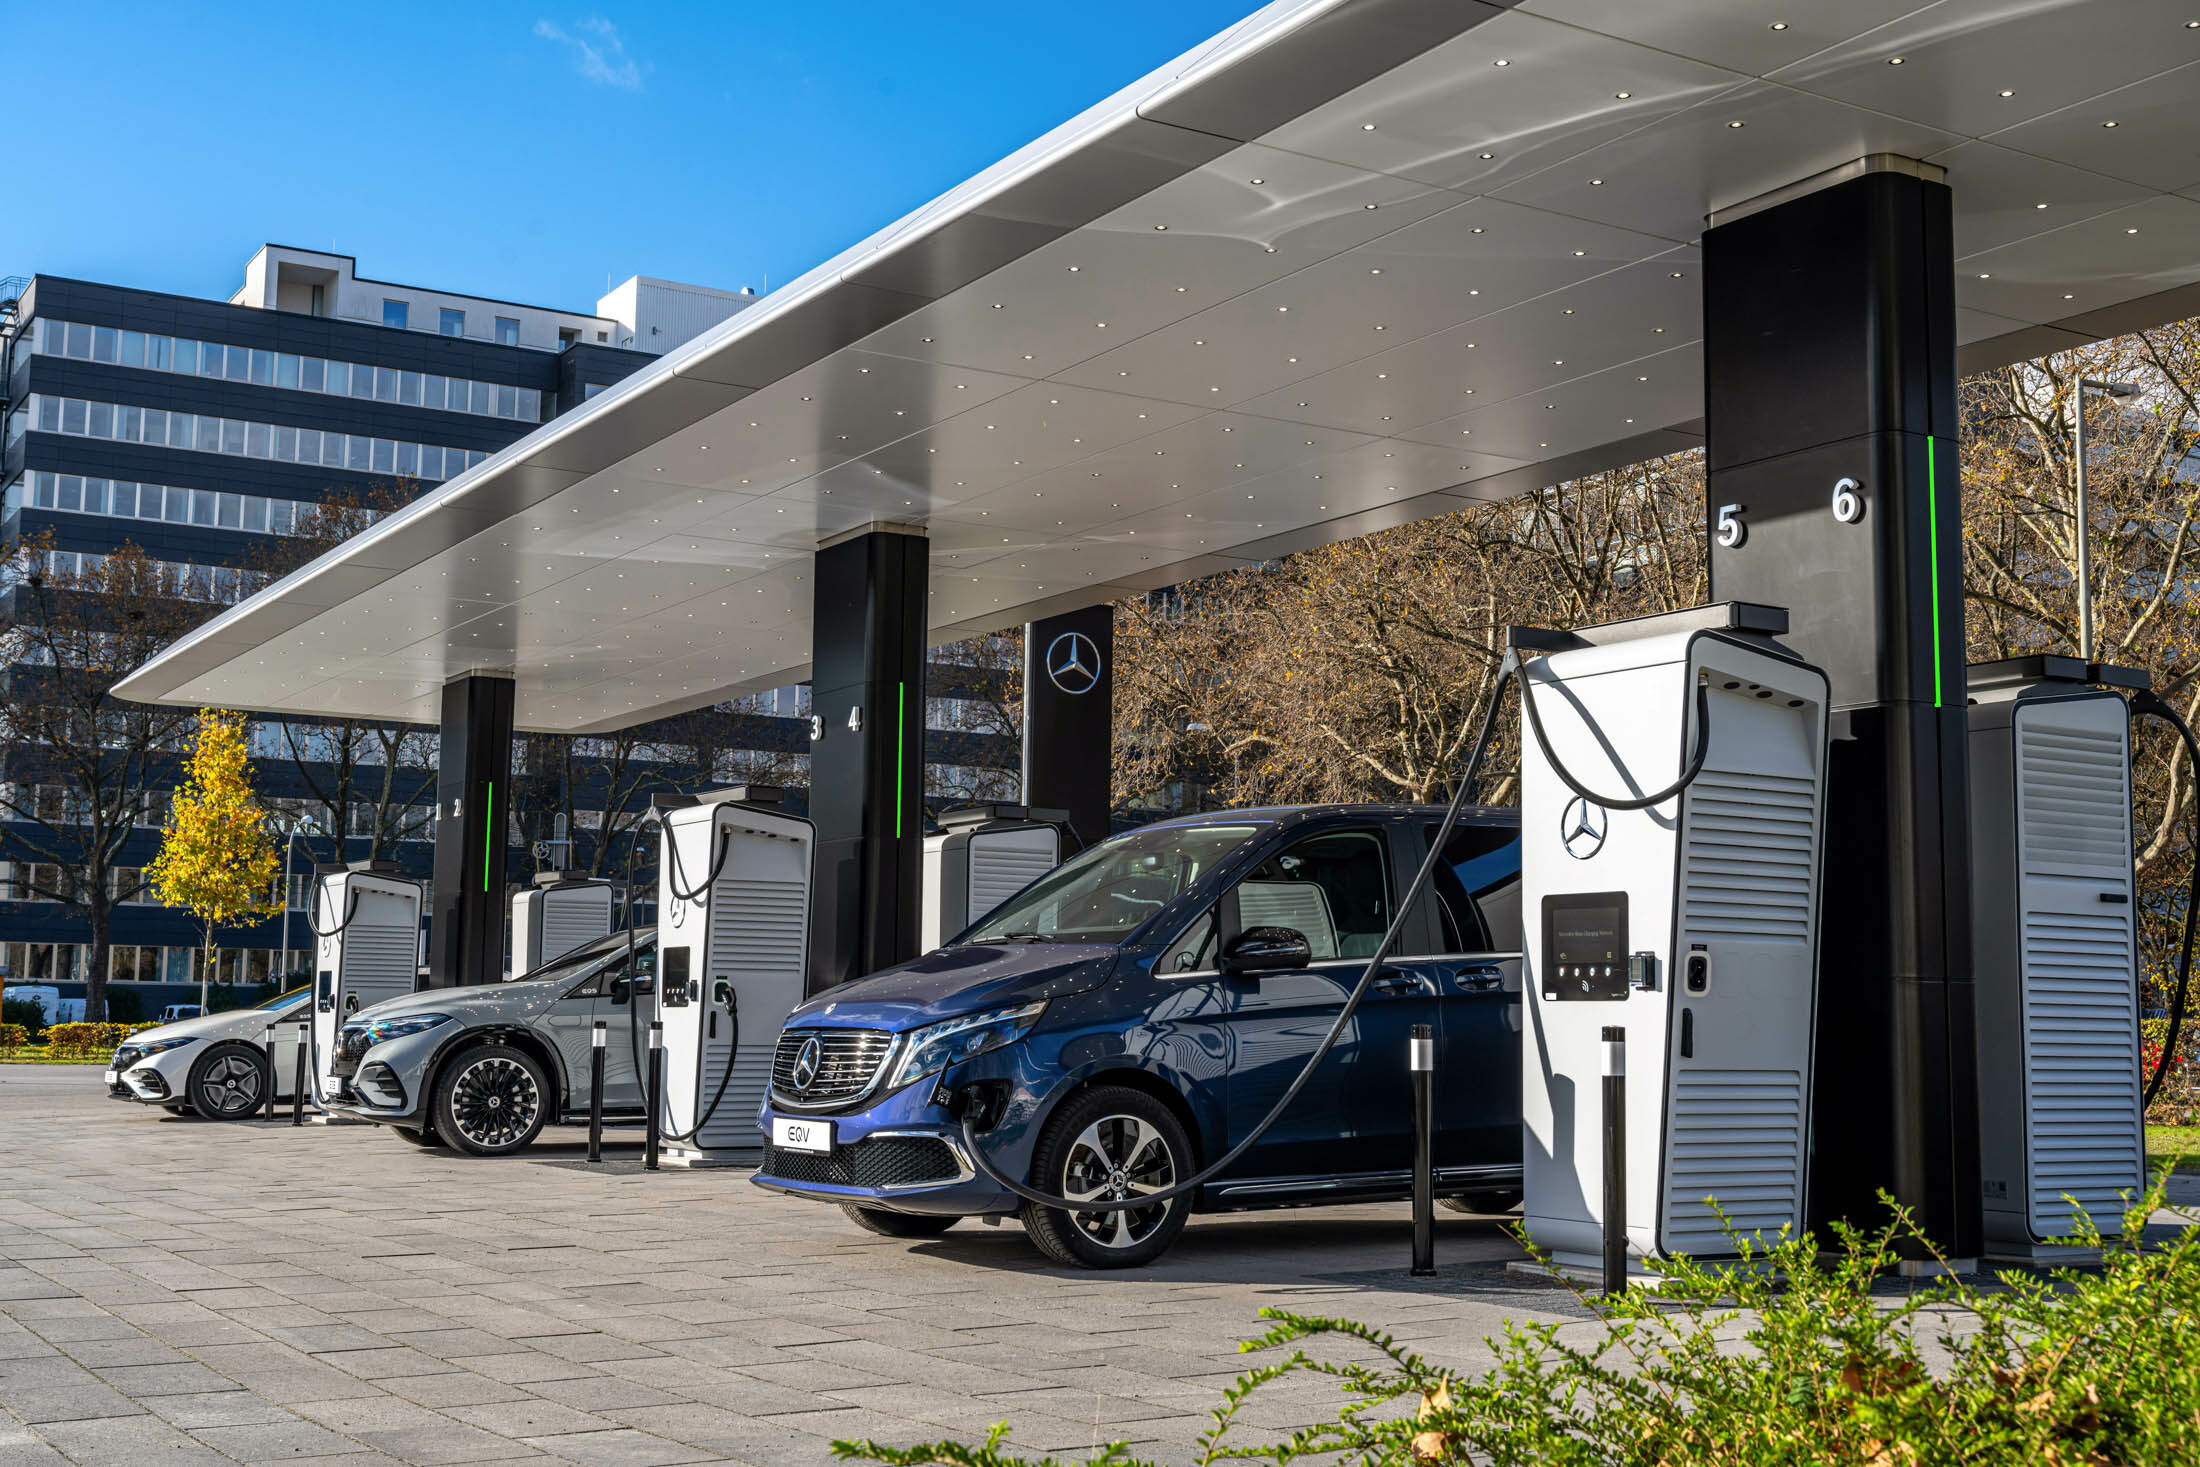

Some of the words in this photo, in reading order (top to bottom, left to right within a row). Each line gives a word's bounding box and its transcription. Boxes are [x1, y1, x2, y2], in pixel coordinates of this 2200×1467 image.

[1832, 477, 1860, 522] 6
[1717, 503, 1742, 547] 5
[810, 715, 822, 740] 3
[848, 706, 861, 731] 4
[453, 798, 461, 817] 2
[787, 1126, 810, 1142] EQV
